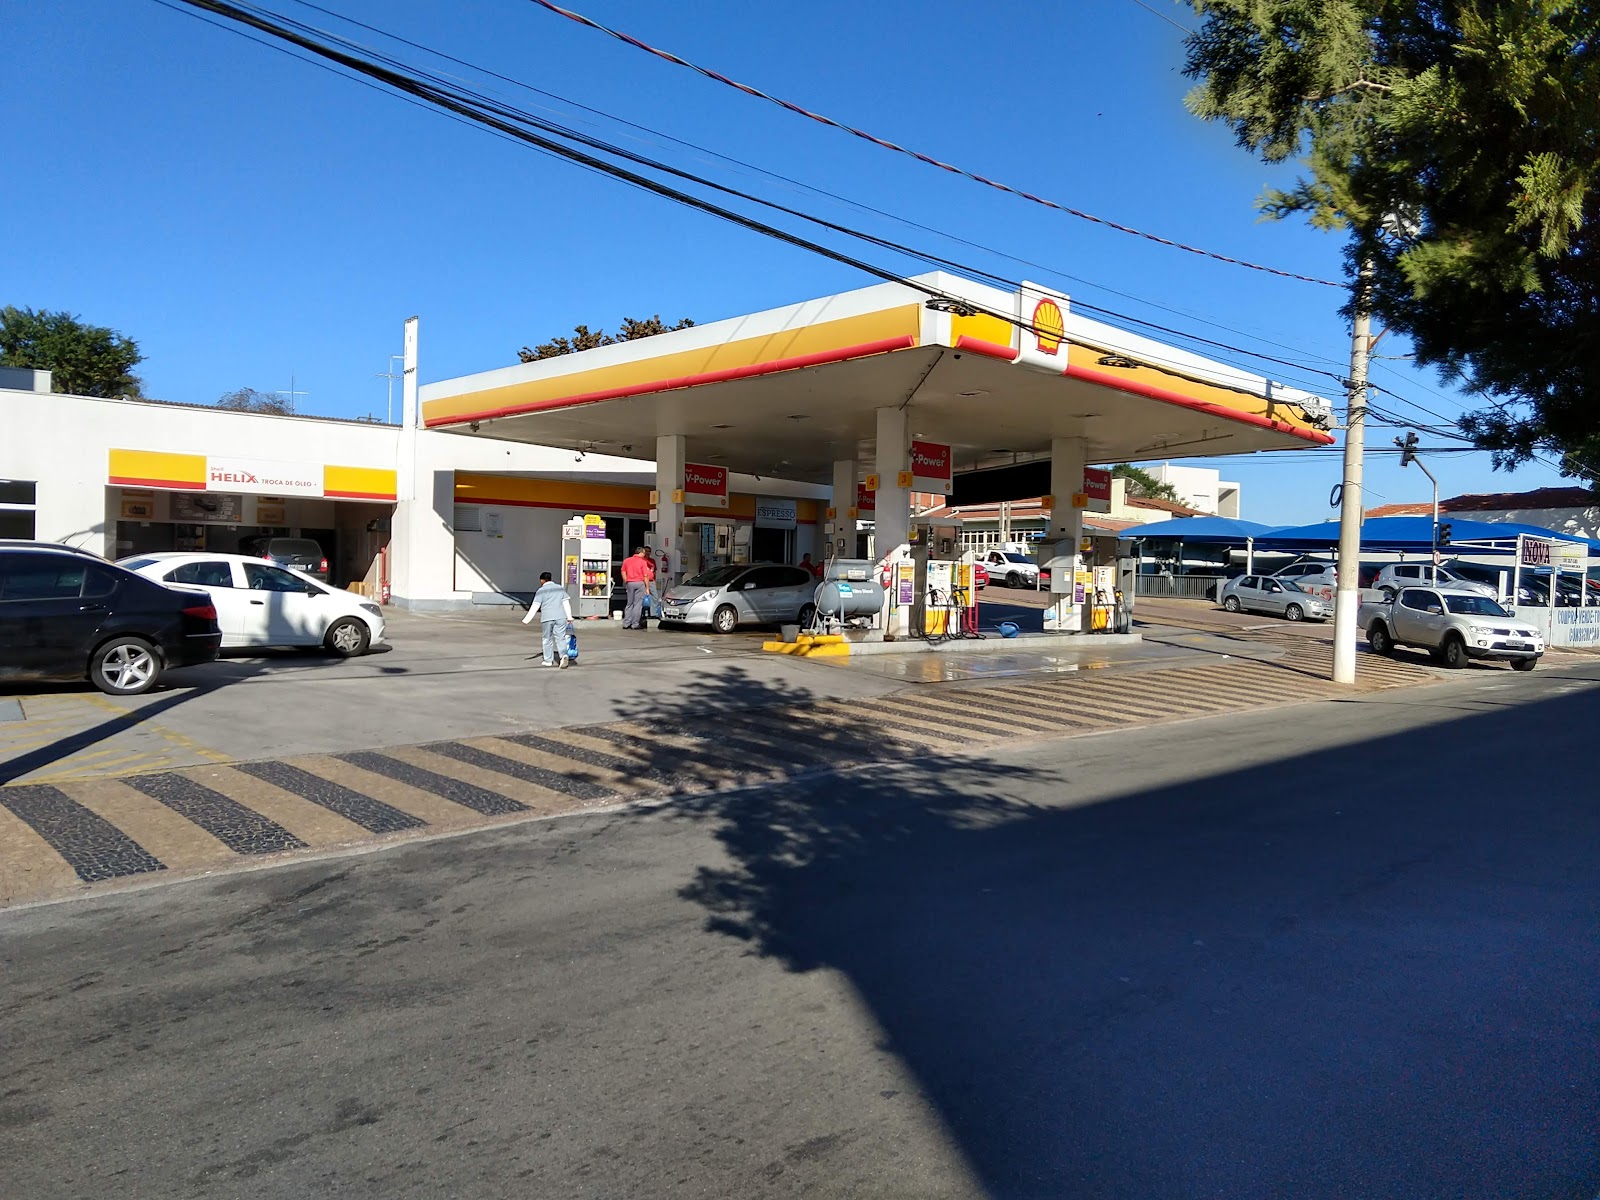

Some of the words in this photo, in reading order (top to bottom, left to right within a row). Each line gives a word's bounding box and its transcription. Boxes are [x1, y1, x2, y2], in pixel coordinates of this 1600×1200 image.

[211, 472, 258, 484] HELIX
[261, 478, 284, 486] TROCA
[685, 473, 721, 486] V-Power
[869, 477, 876, 487] 4
[901, 474, 908, 484] 3
[1084, 478, 1107, 490] -Power
[1044, 498, 1051, 506] 2
[757, 508, 796, 519] ESPRESSO
[1524, 540, 1551, 565] NOVA
